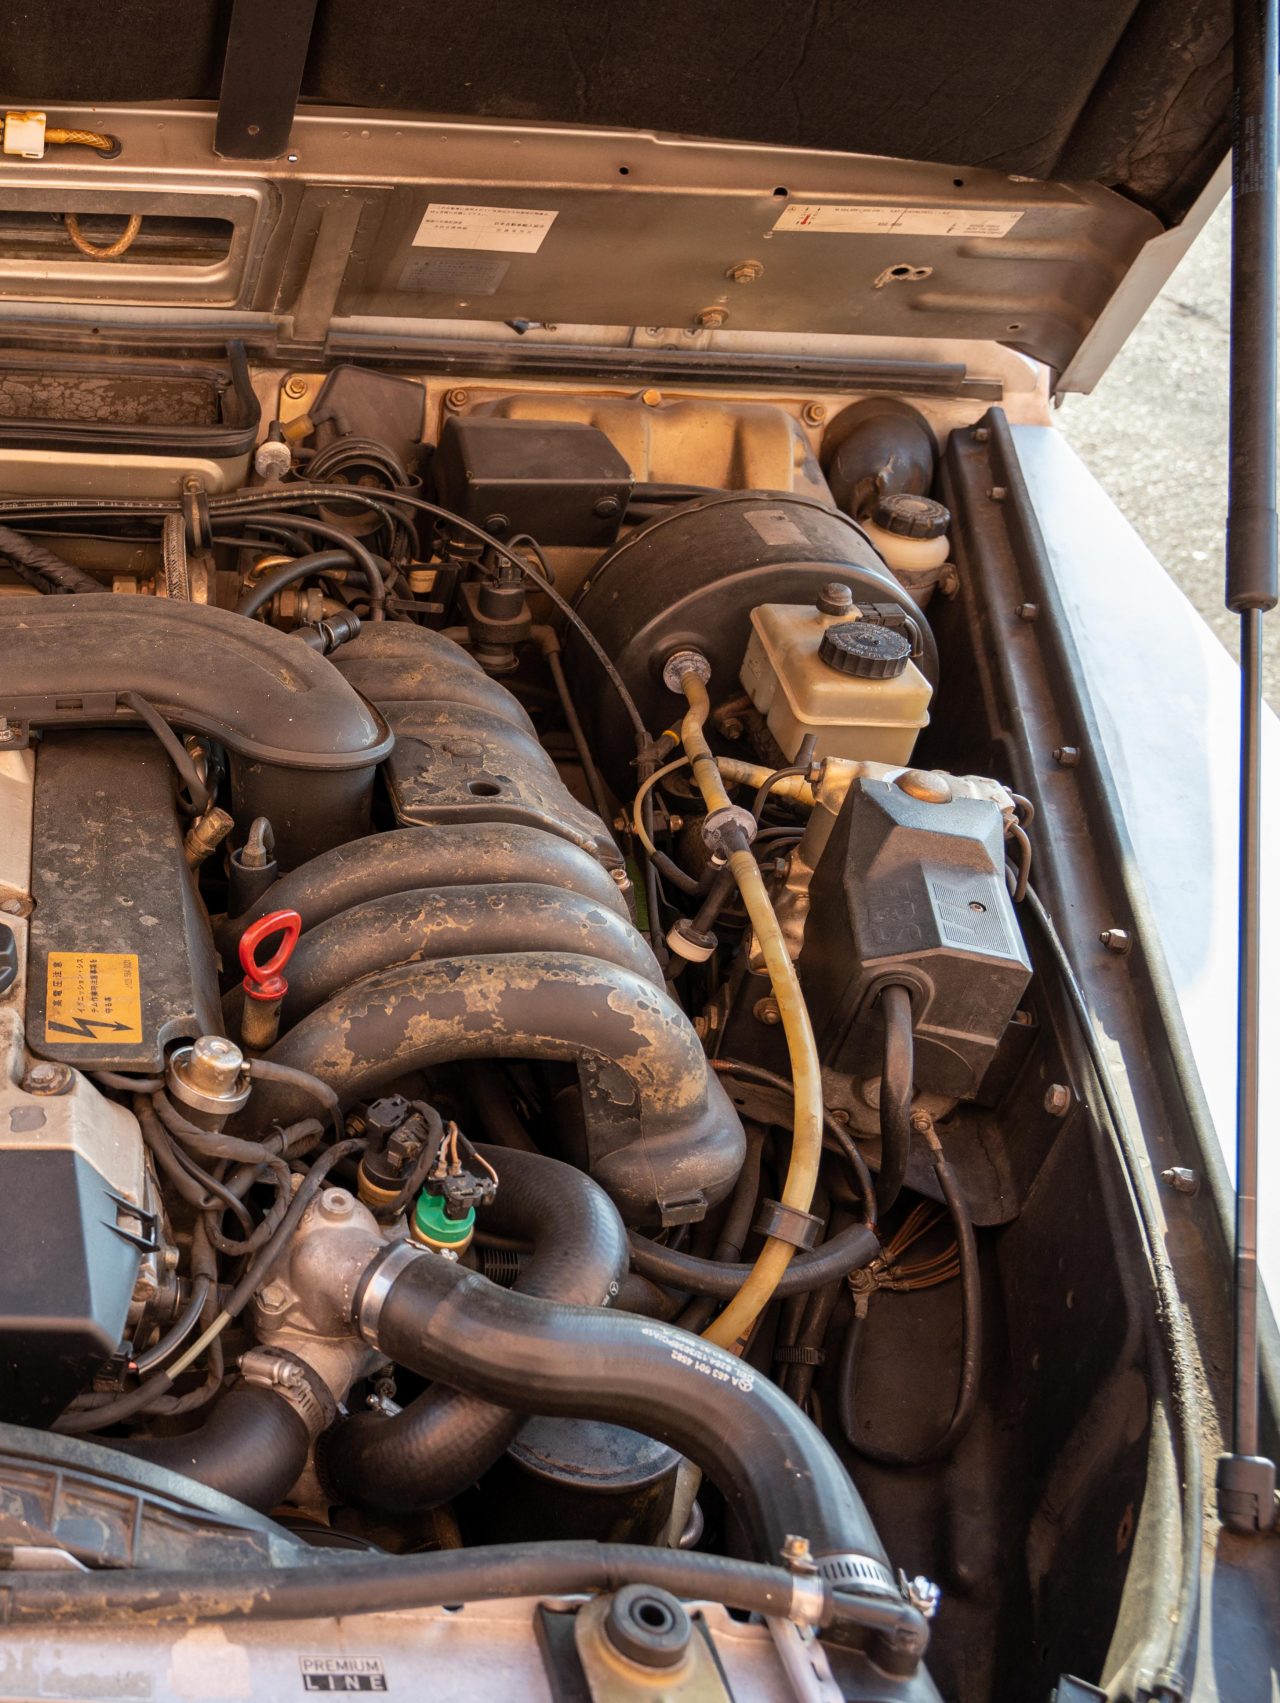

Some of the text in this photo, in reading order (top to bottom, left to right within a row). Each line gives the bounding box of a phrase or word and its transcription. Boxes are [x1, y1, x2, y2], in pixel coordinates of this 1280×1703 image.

[52, 960, 63, 1007] 高電圧注意
[303, 1658, 380, 1672] PREMIUM
[305, 1674, 385, 1691] LINE
